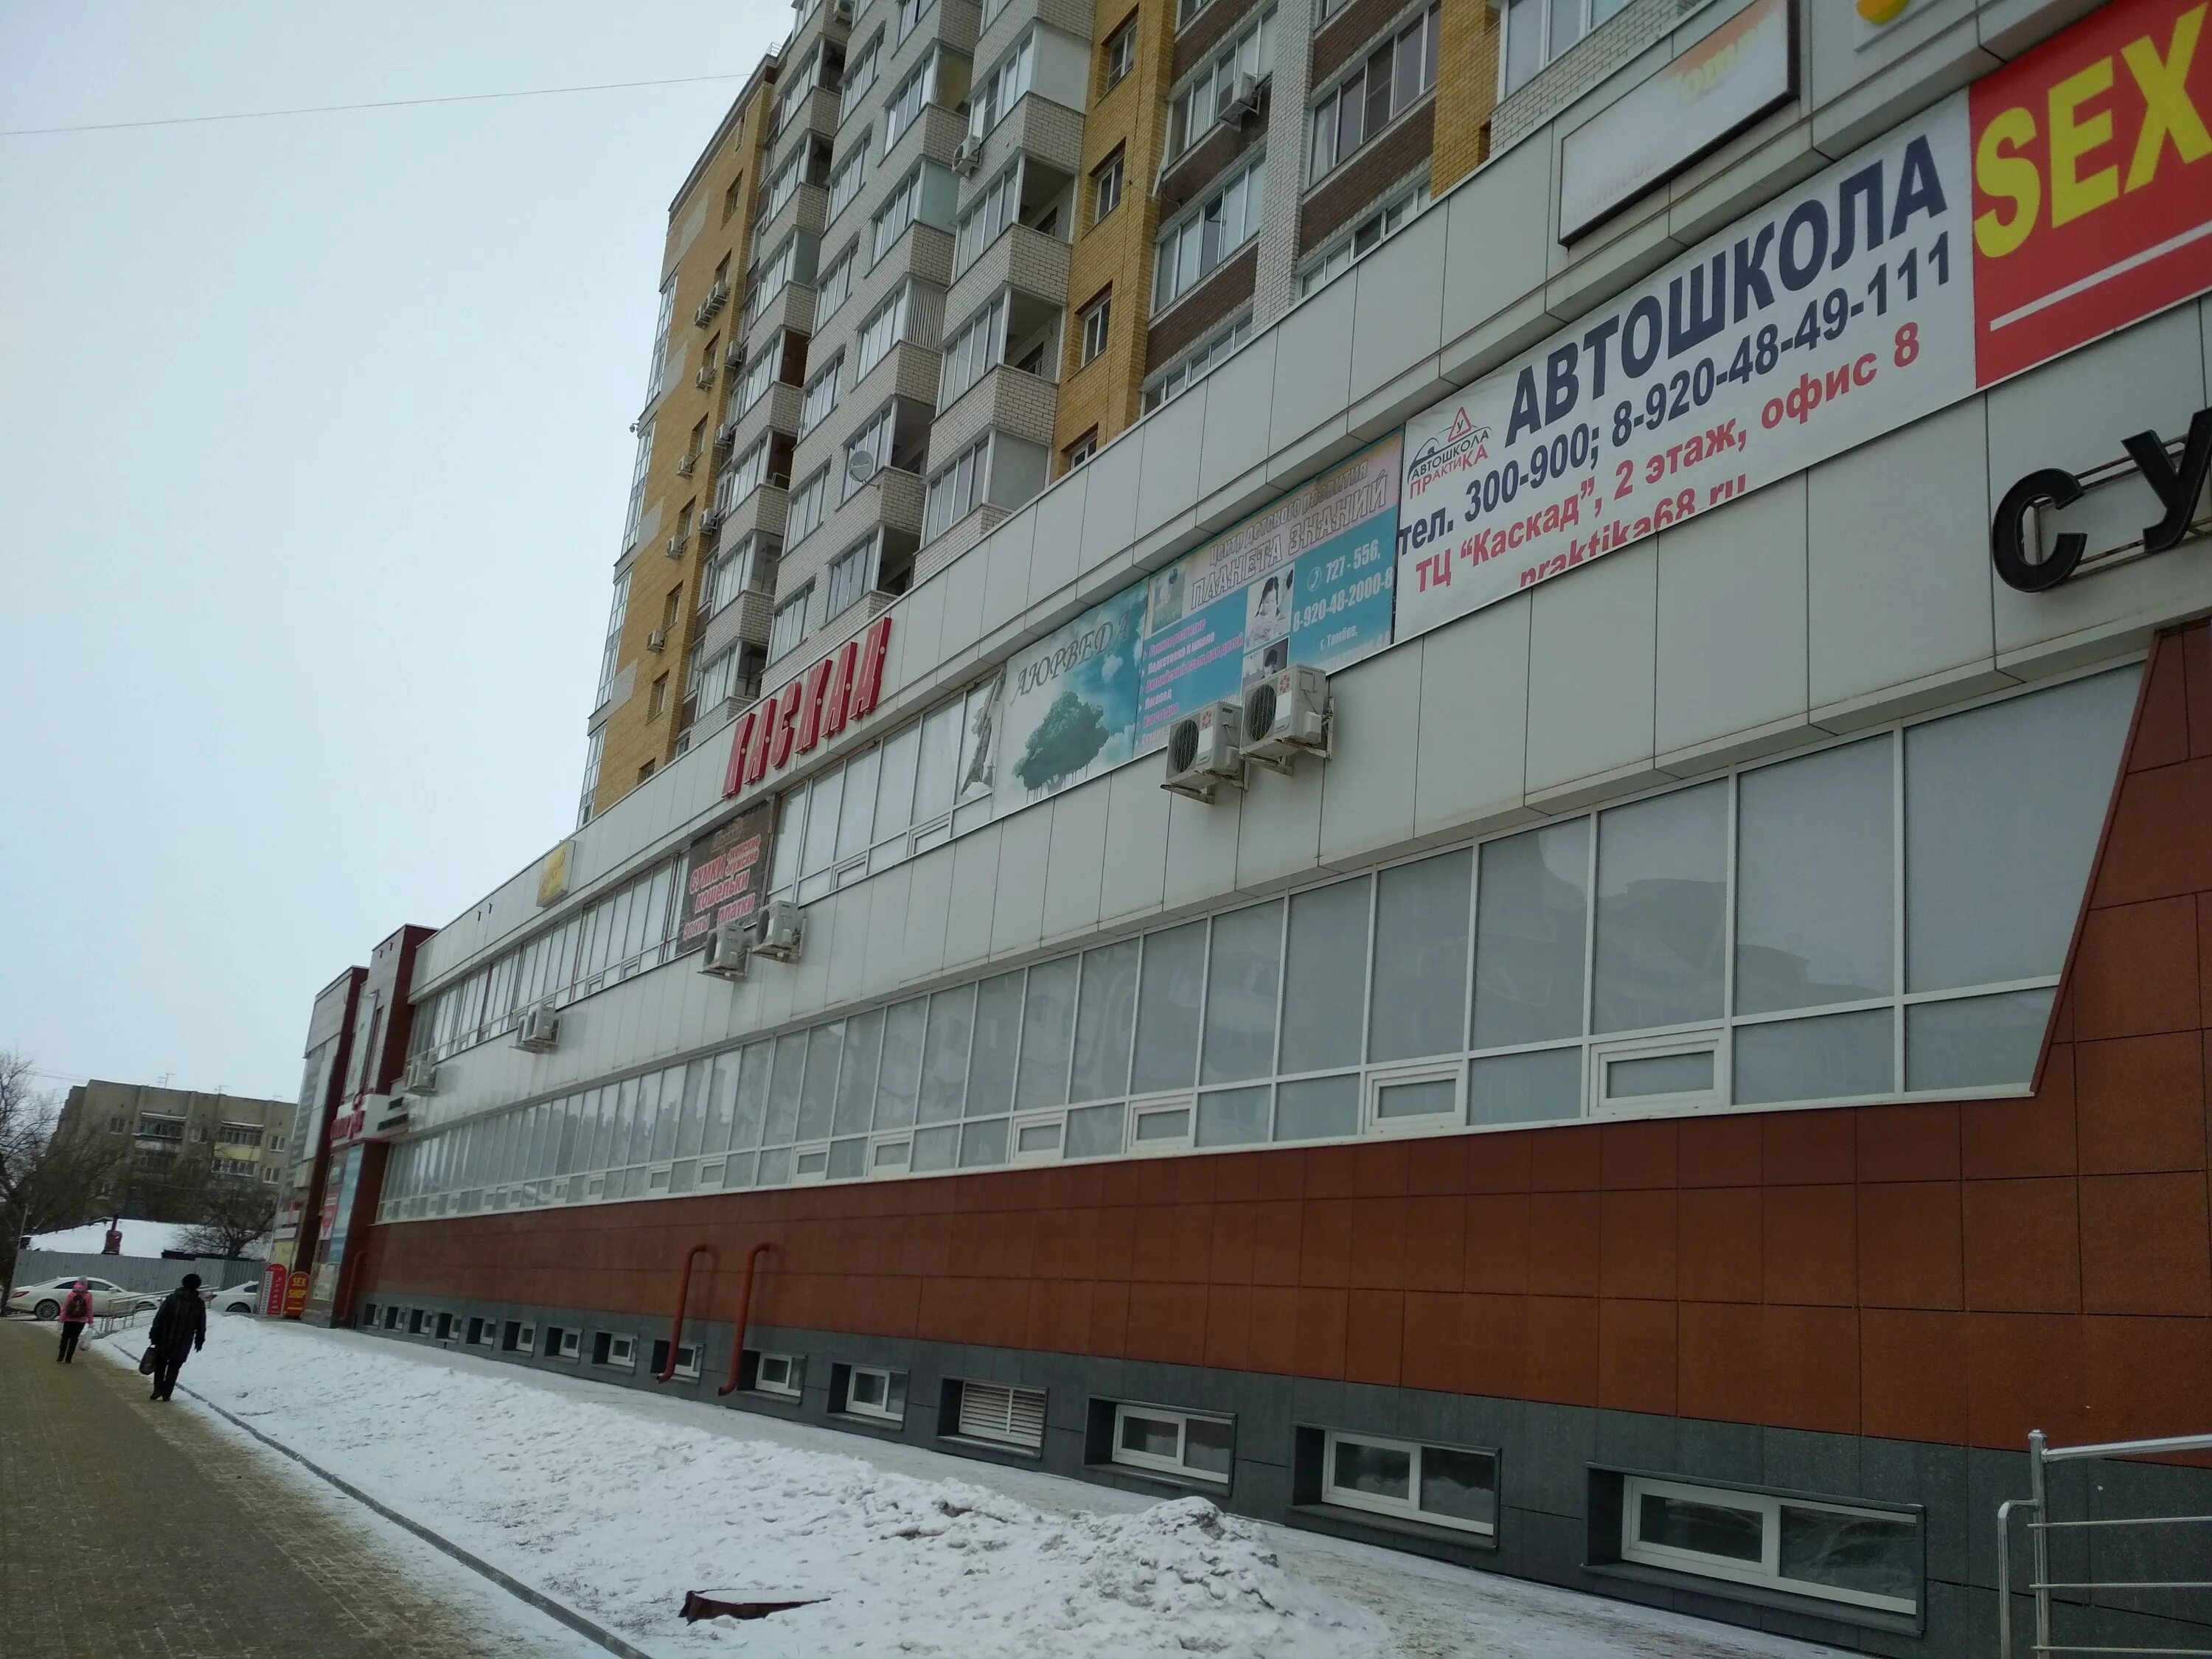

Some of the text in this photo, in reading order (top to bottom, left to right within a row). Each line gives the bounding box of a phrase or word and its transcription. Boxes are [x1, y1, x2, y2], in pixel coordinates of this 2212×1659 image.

[1974, 1, 2212, 257] SEX
[1505, 134, 1948, 448] АВТОШКОЛА
[1398, 231, 1949, 556] тел. 300-900; 8-920-48-49-111
[1411, 429, 1489, 480] АВТОШКОЛА
[1416, 549, 1452, 592] ТЦ
[1614, 459, 1634, 501] 2
[1645, 417, 1747, 484] этаж,
[1761, 352, 1878, 430] офис
[1893, 321, 1920, 367] 8
[1191, 468, 1388, 611] ПЛАНЕТА ЗНАНИЙ
[722, 617, 891, 799] КАСКАД
[288, 1289, 307, 1298] SHOP
[292, 1277, 307, 1287] SEX
